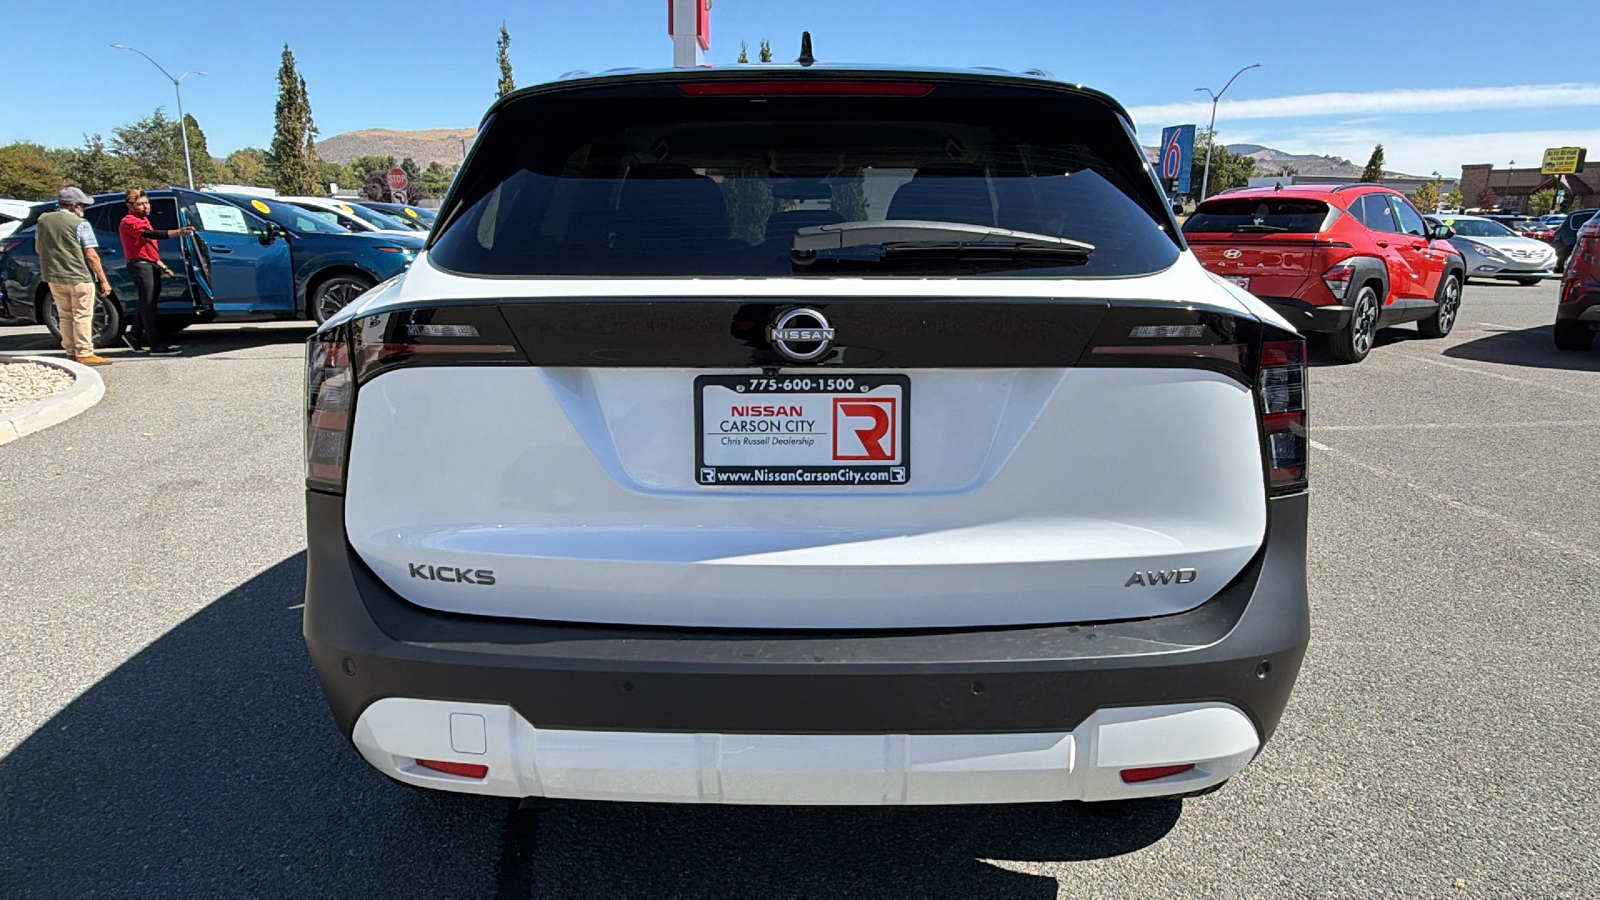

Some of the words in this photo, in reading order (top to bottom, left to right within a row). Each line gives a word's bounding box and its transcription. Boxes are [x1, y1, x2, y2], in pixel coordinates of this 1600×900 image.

[1163, 127, 1182, 179] 6
[389, 174, 405, 183] STOP
[773, 331, 833, 339] NISSAN
[749, 378, 855, 391] 775-600-1500
[731, 405, 803, 417] NISSAN
[719, 419, 781, 433] CARSON
[785, 419, 815, 433] CITY
[720, 436, 742, 446] Chris
[743, 436, 770, 446] Russell
[771, 436, 815, 447] Dealership
[717, 468, 889, 484] www.NissanCarsonCity.com
[408, 562, 496, 586] KICKS
[1124, 567, 1198, 588] AWD
